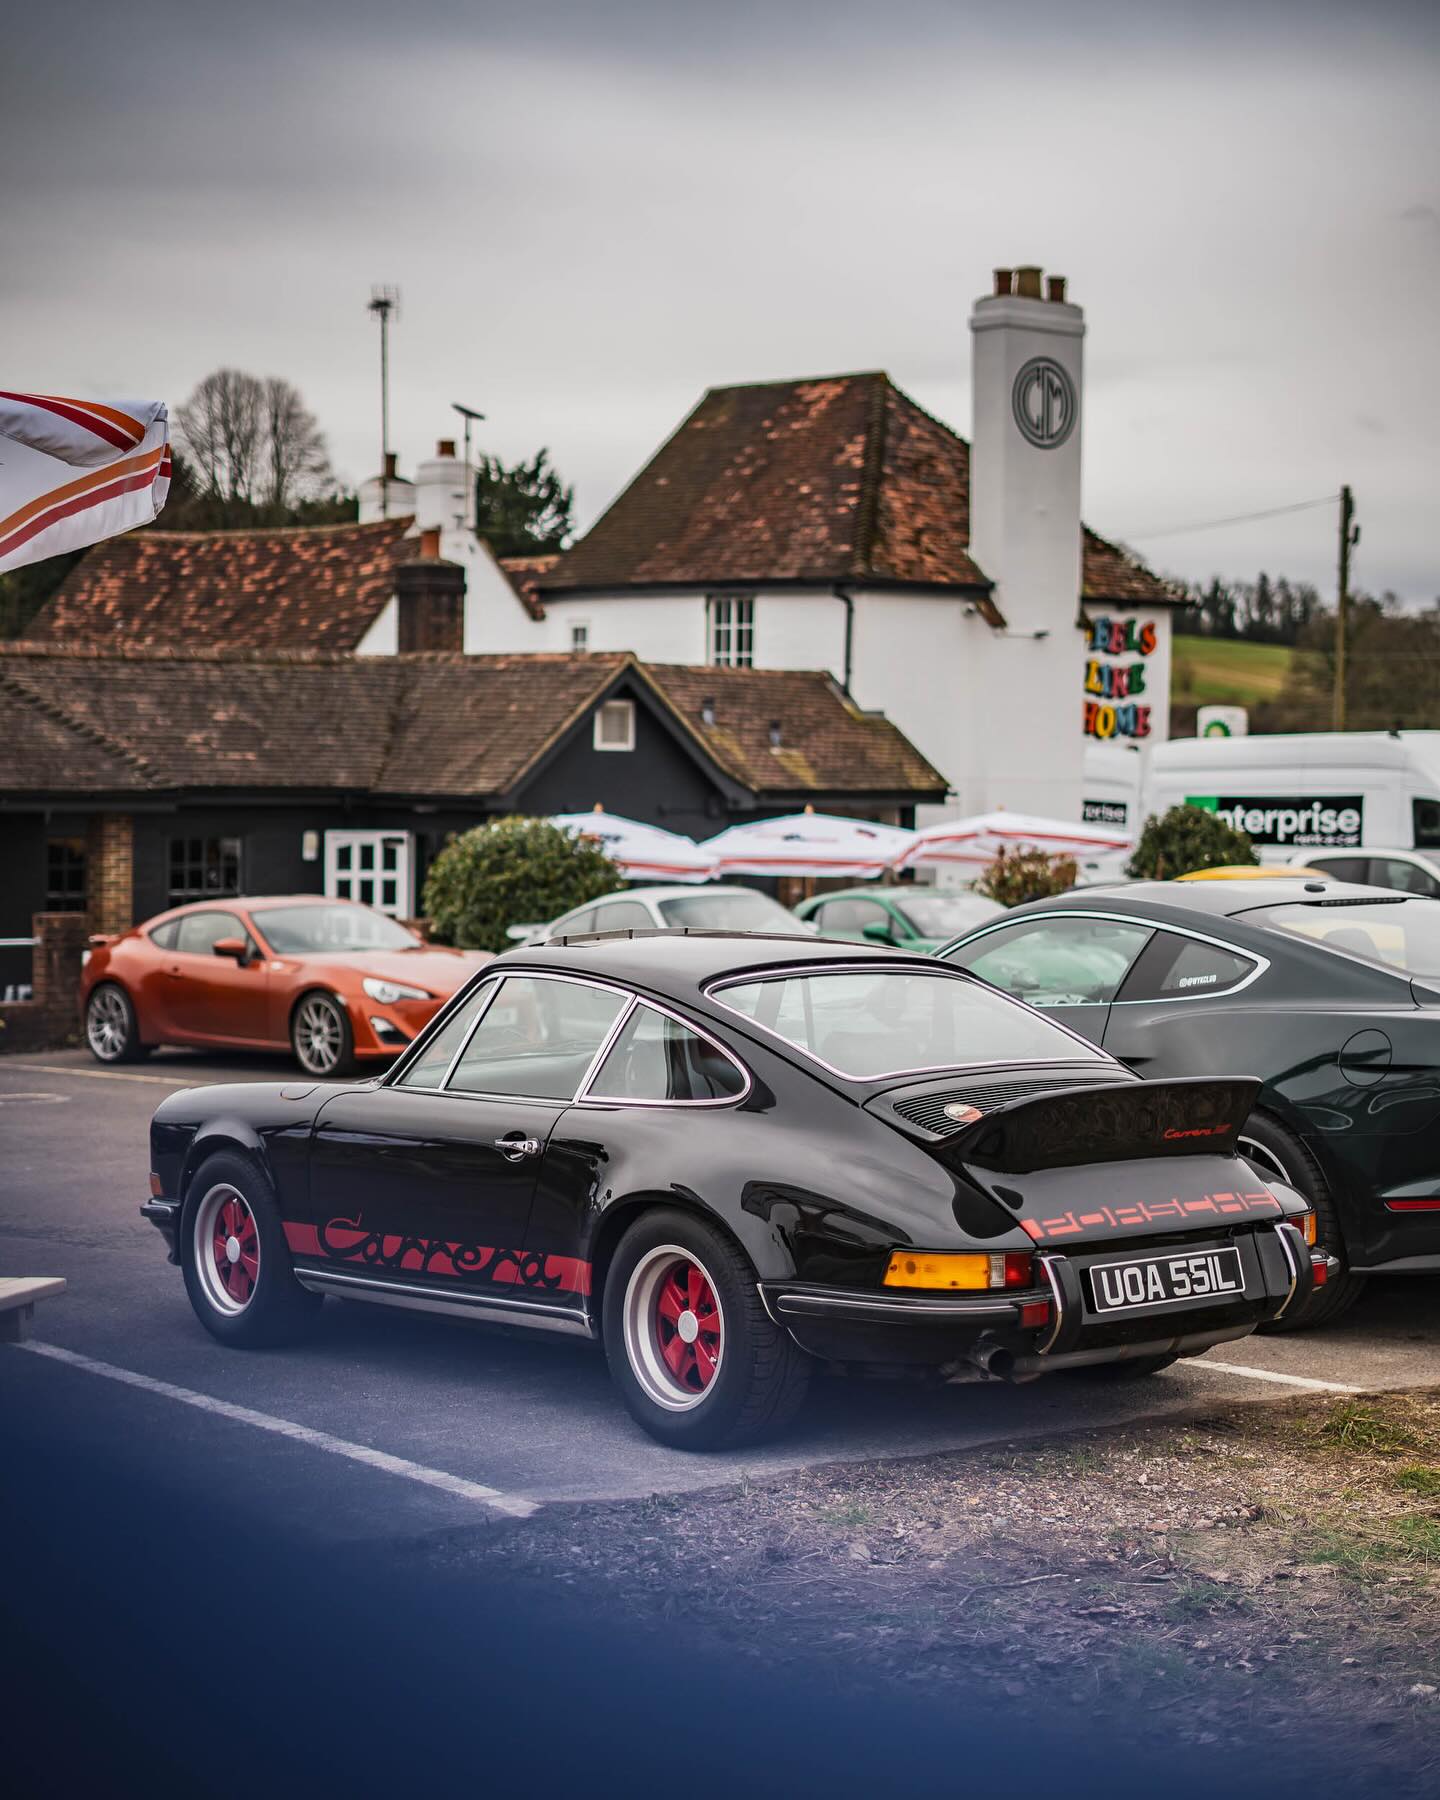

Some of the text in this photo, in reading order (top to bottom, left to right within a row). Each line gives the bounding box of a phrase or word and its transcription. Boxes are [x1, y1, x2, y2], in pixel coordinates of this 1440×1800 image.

[1085, 617, 1156, 655] EELS
[1085, 659, 1145, 698] LIKE
[1083, 701, 1152, 738] HOME
[1204, 801, 1361, 841] nterprise
[1163, 1128, 1214, 1139] Carrera
[1034, 1193, 1274, 1239] PORSCHE
[314, 1211, 562, 1288] Carrera
[1101, 1255, 1236, 1306] UOA 551L
